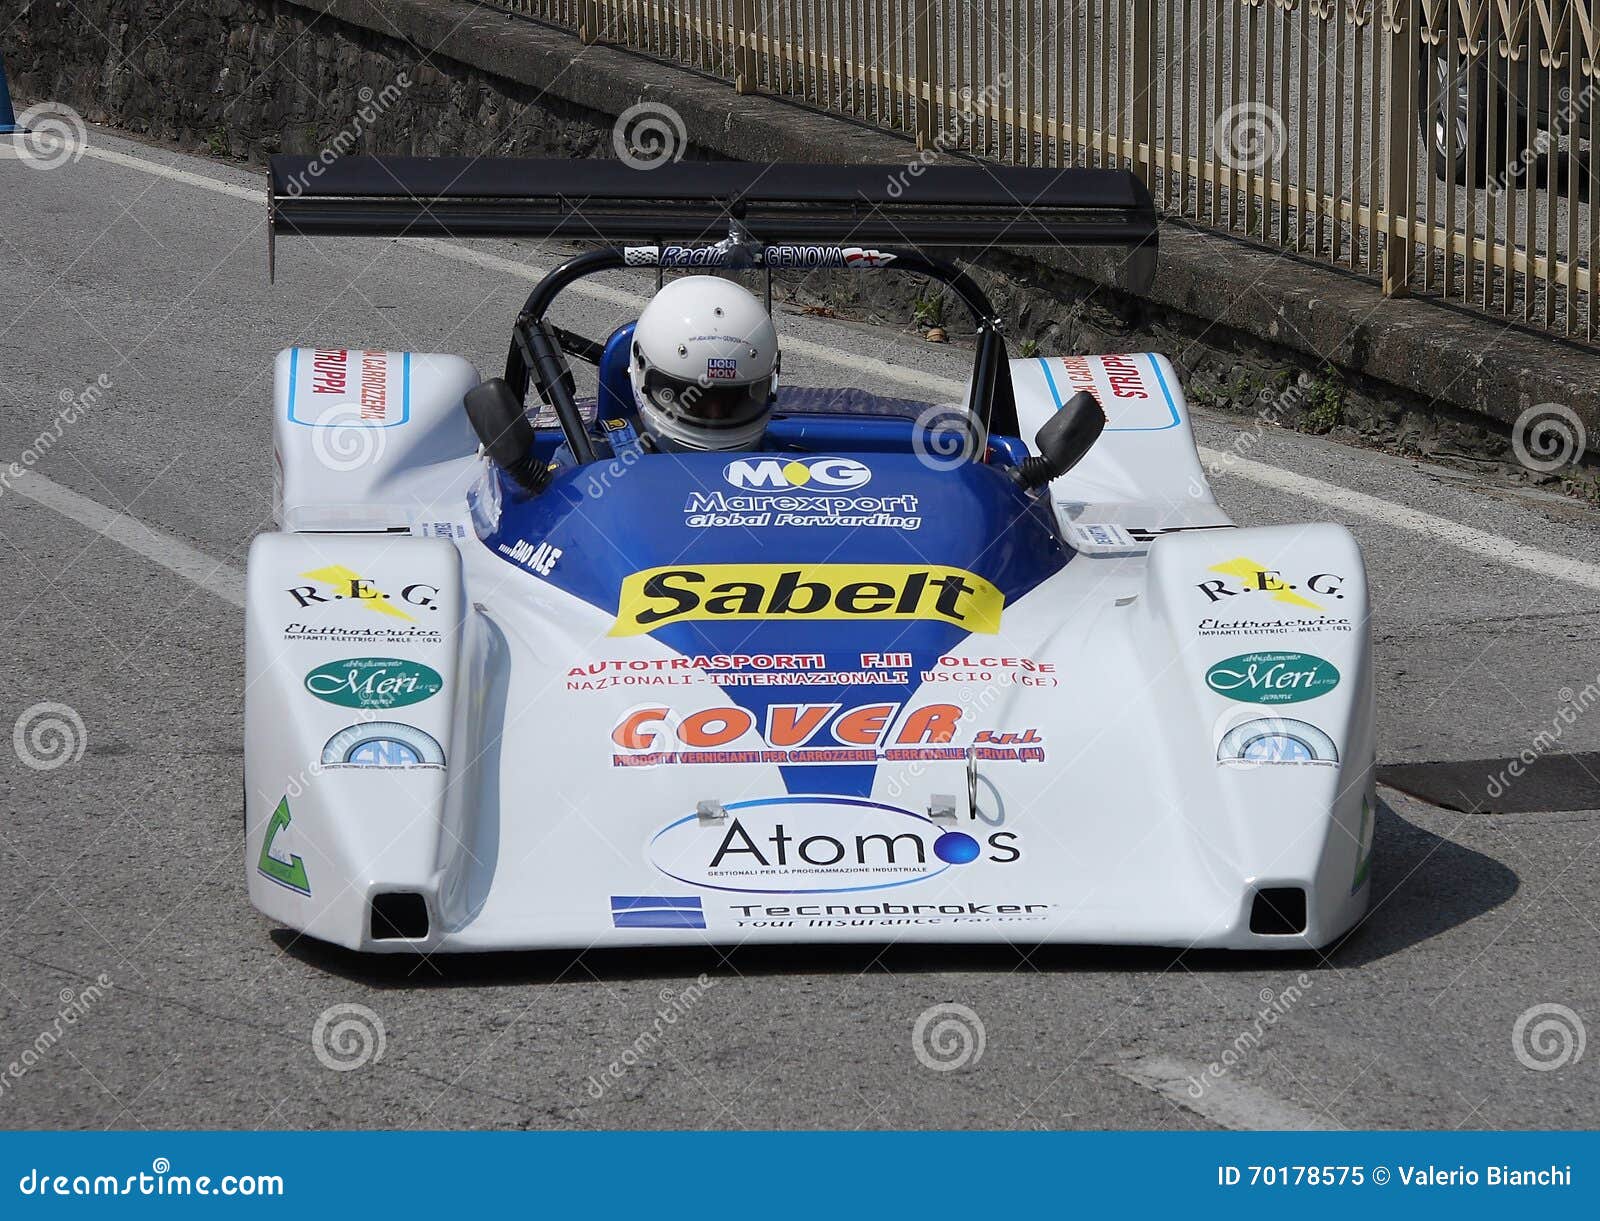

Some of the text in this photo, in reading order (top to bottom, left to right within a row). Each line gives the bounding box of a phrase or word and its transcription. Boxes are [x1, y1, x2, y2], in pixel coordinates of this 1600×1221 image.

[765, 246, 843, 268] GENOVA
[708, 359, 736, 369] LIQUI
[708, 368, 736, 378] MOLY
[361, 359, 388, 420] CARROZZERIA
[684, 491, 918, 515] Marexport
[685, 513, 921, 530] Global Forwarding
[527, 542, 563, 577] ALE
[635, 570, 976, 624] Sabelt
[285, 623, 441, 636] Elettroservice
[1198, 616, 1351, 629] Elettroservice
[567, 654, 824, 676] AUTOTRASPORTI
[307, 669, 420, 695] Meri
[922, 671, 992, 683] USCIO
[1011, 672, 1059, 688] (GE)
[1208, 662, 1318, 690] Meri
[611, 703, 964, 748] COVER
[613, 752, 677, 767] PRODOTTI
[679, 751, 760, 764] VERNICIANTI
[761, 751, 788, 763] PER
[1019, 747, 1045, 762] (AL)
[729, 902, 1048, 918] Tecnobroker
[735, 918, 795, 928] Your
[808, 918, 942, 928] Insurance
